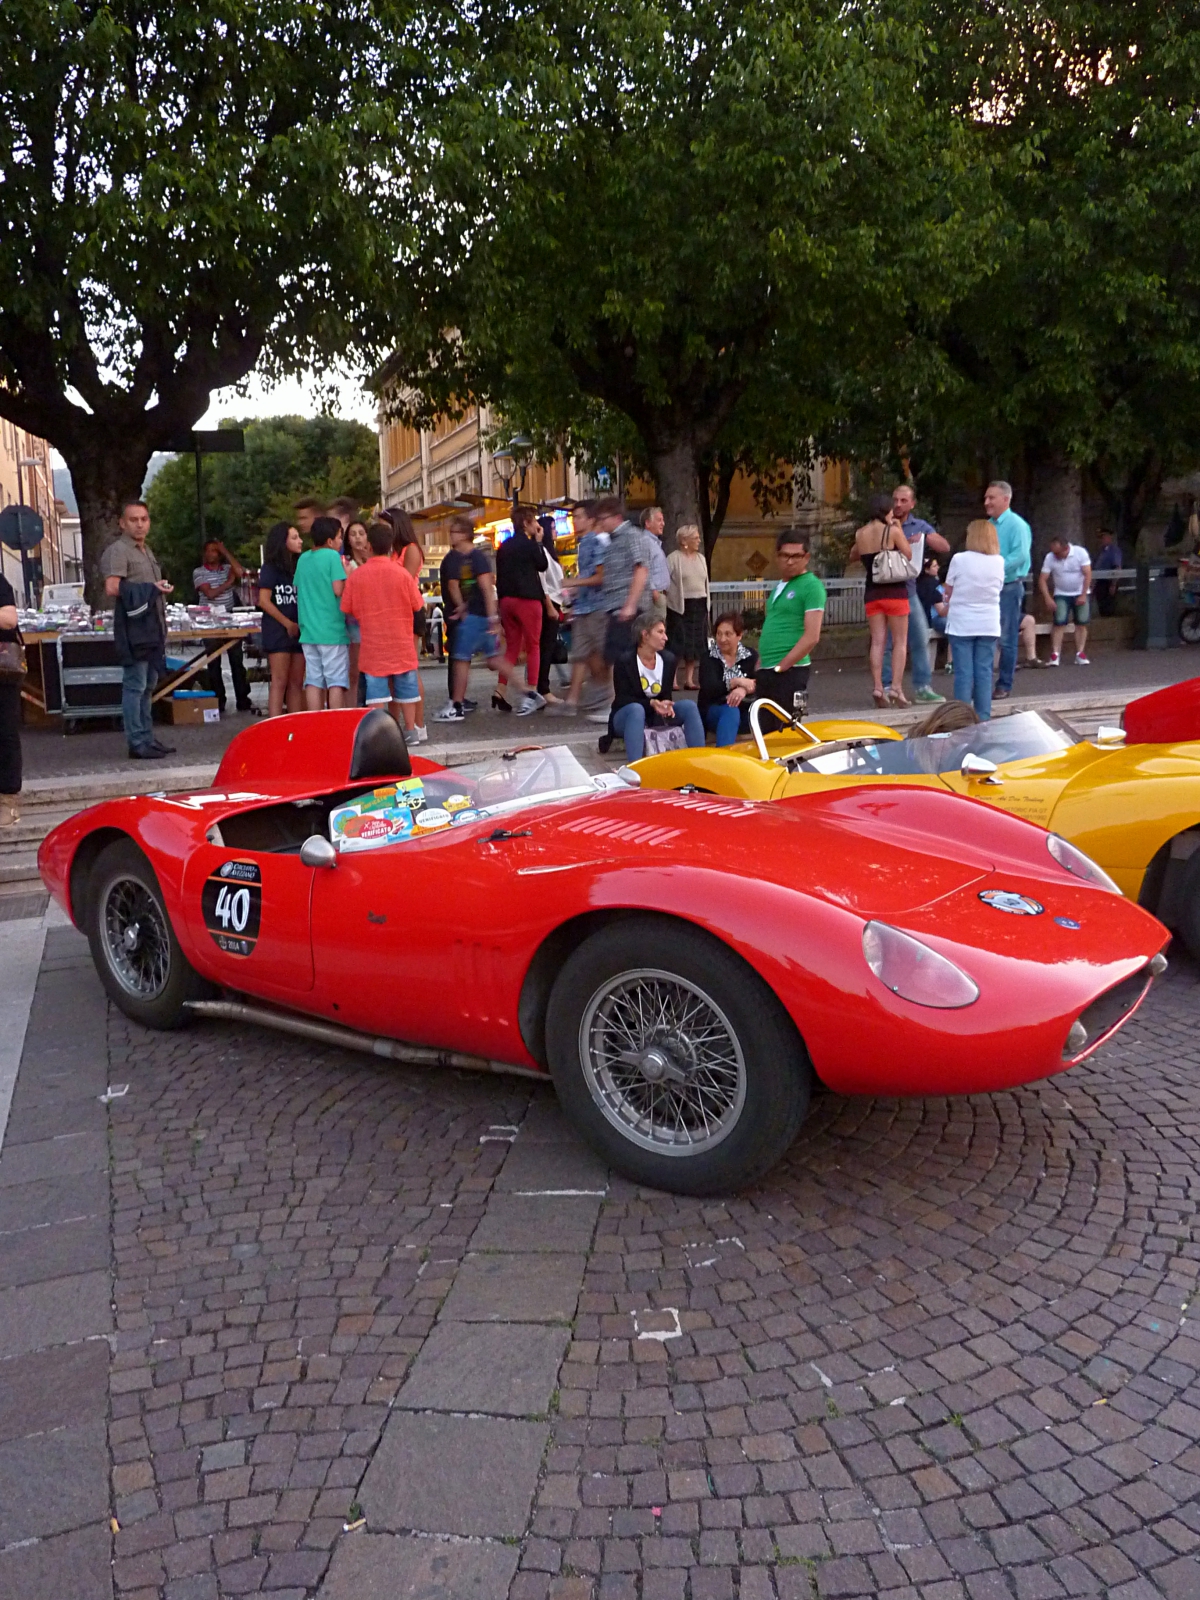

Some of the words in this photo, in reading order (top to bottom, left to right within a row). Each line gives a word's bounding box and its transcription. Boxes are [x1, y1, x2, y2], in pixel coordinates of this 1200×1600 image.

[418, 813, 450, 824] VERIFICATO
[361, 826, 392, 838] VERIFICATO
[215, 885, 250, 932] 40
